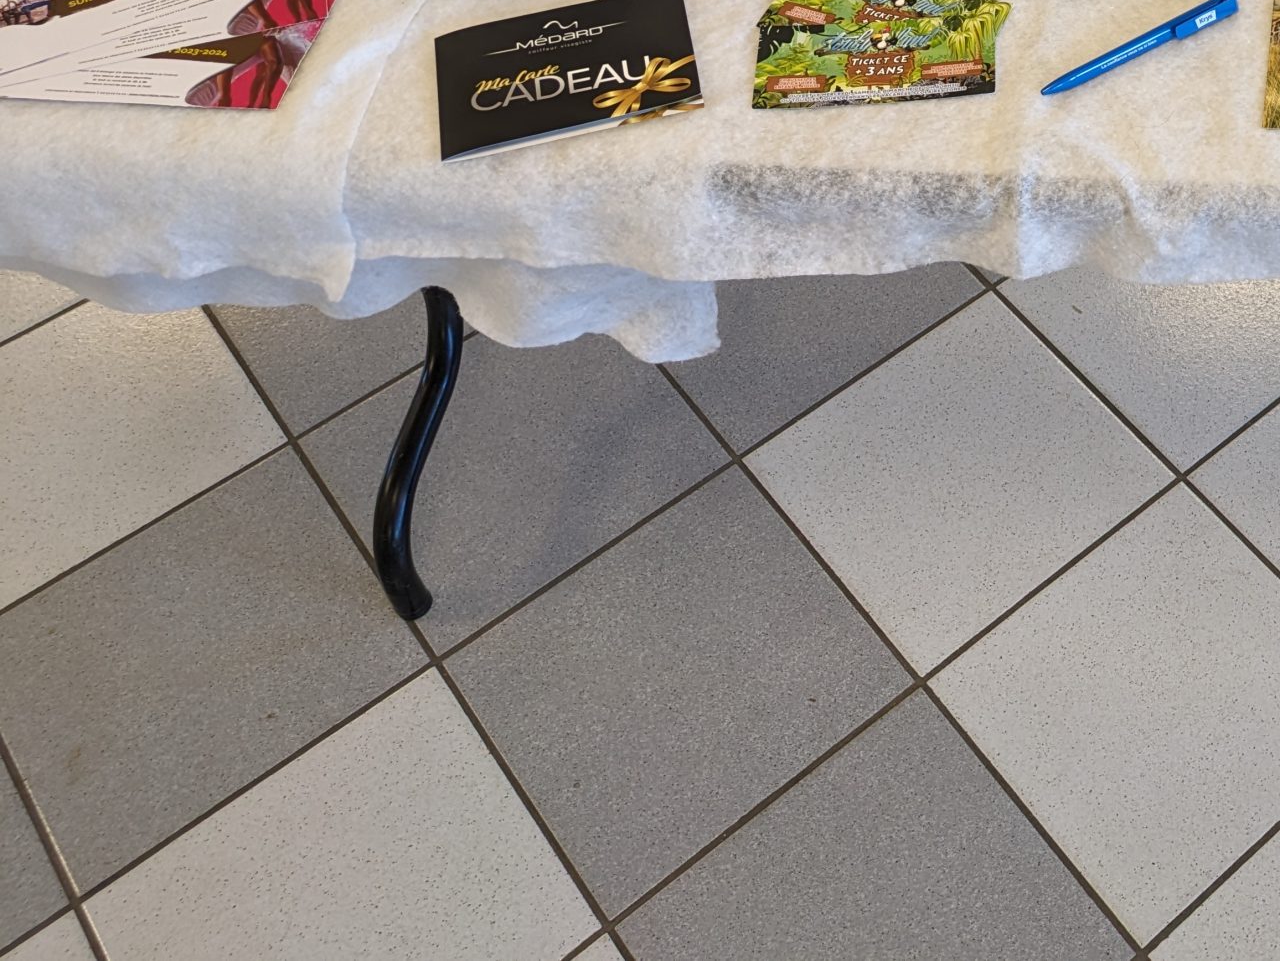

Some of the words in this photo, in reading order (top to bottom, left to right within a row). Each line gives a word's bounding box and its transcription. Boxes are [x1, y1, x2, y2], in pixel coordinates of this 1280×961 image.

[174, 47, 228, 58] 2023-2024
[852, 57, 889, 66] TICKET
[893, 55, 911, 65] CE
[865, 66, 876, 76] 3
[877, 65, 904, 76] ANS
[470, 55, 653, 112] CADEAU
